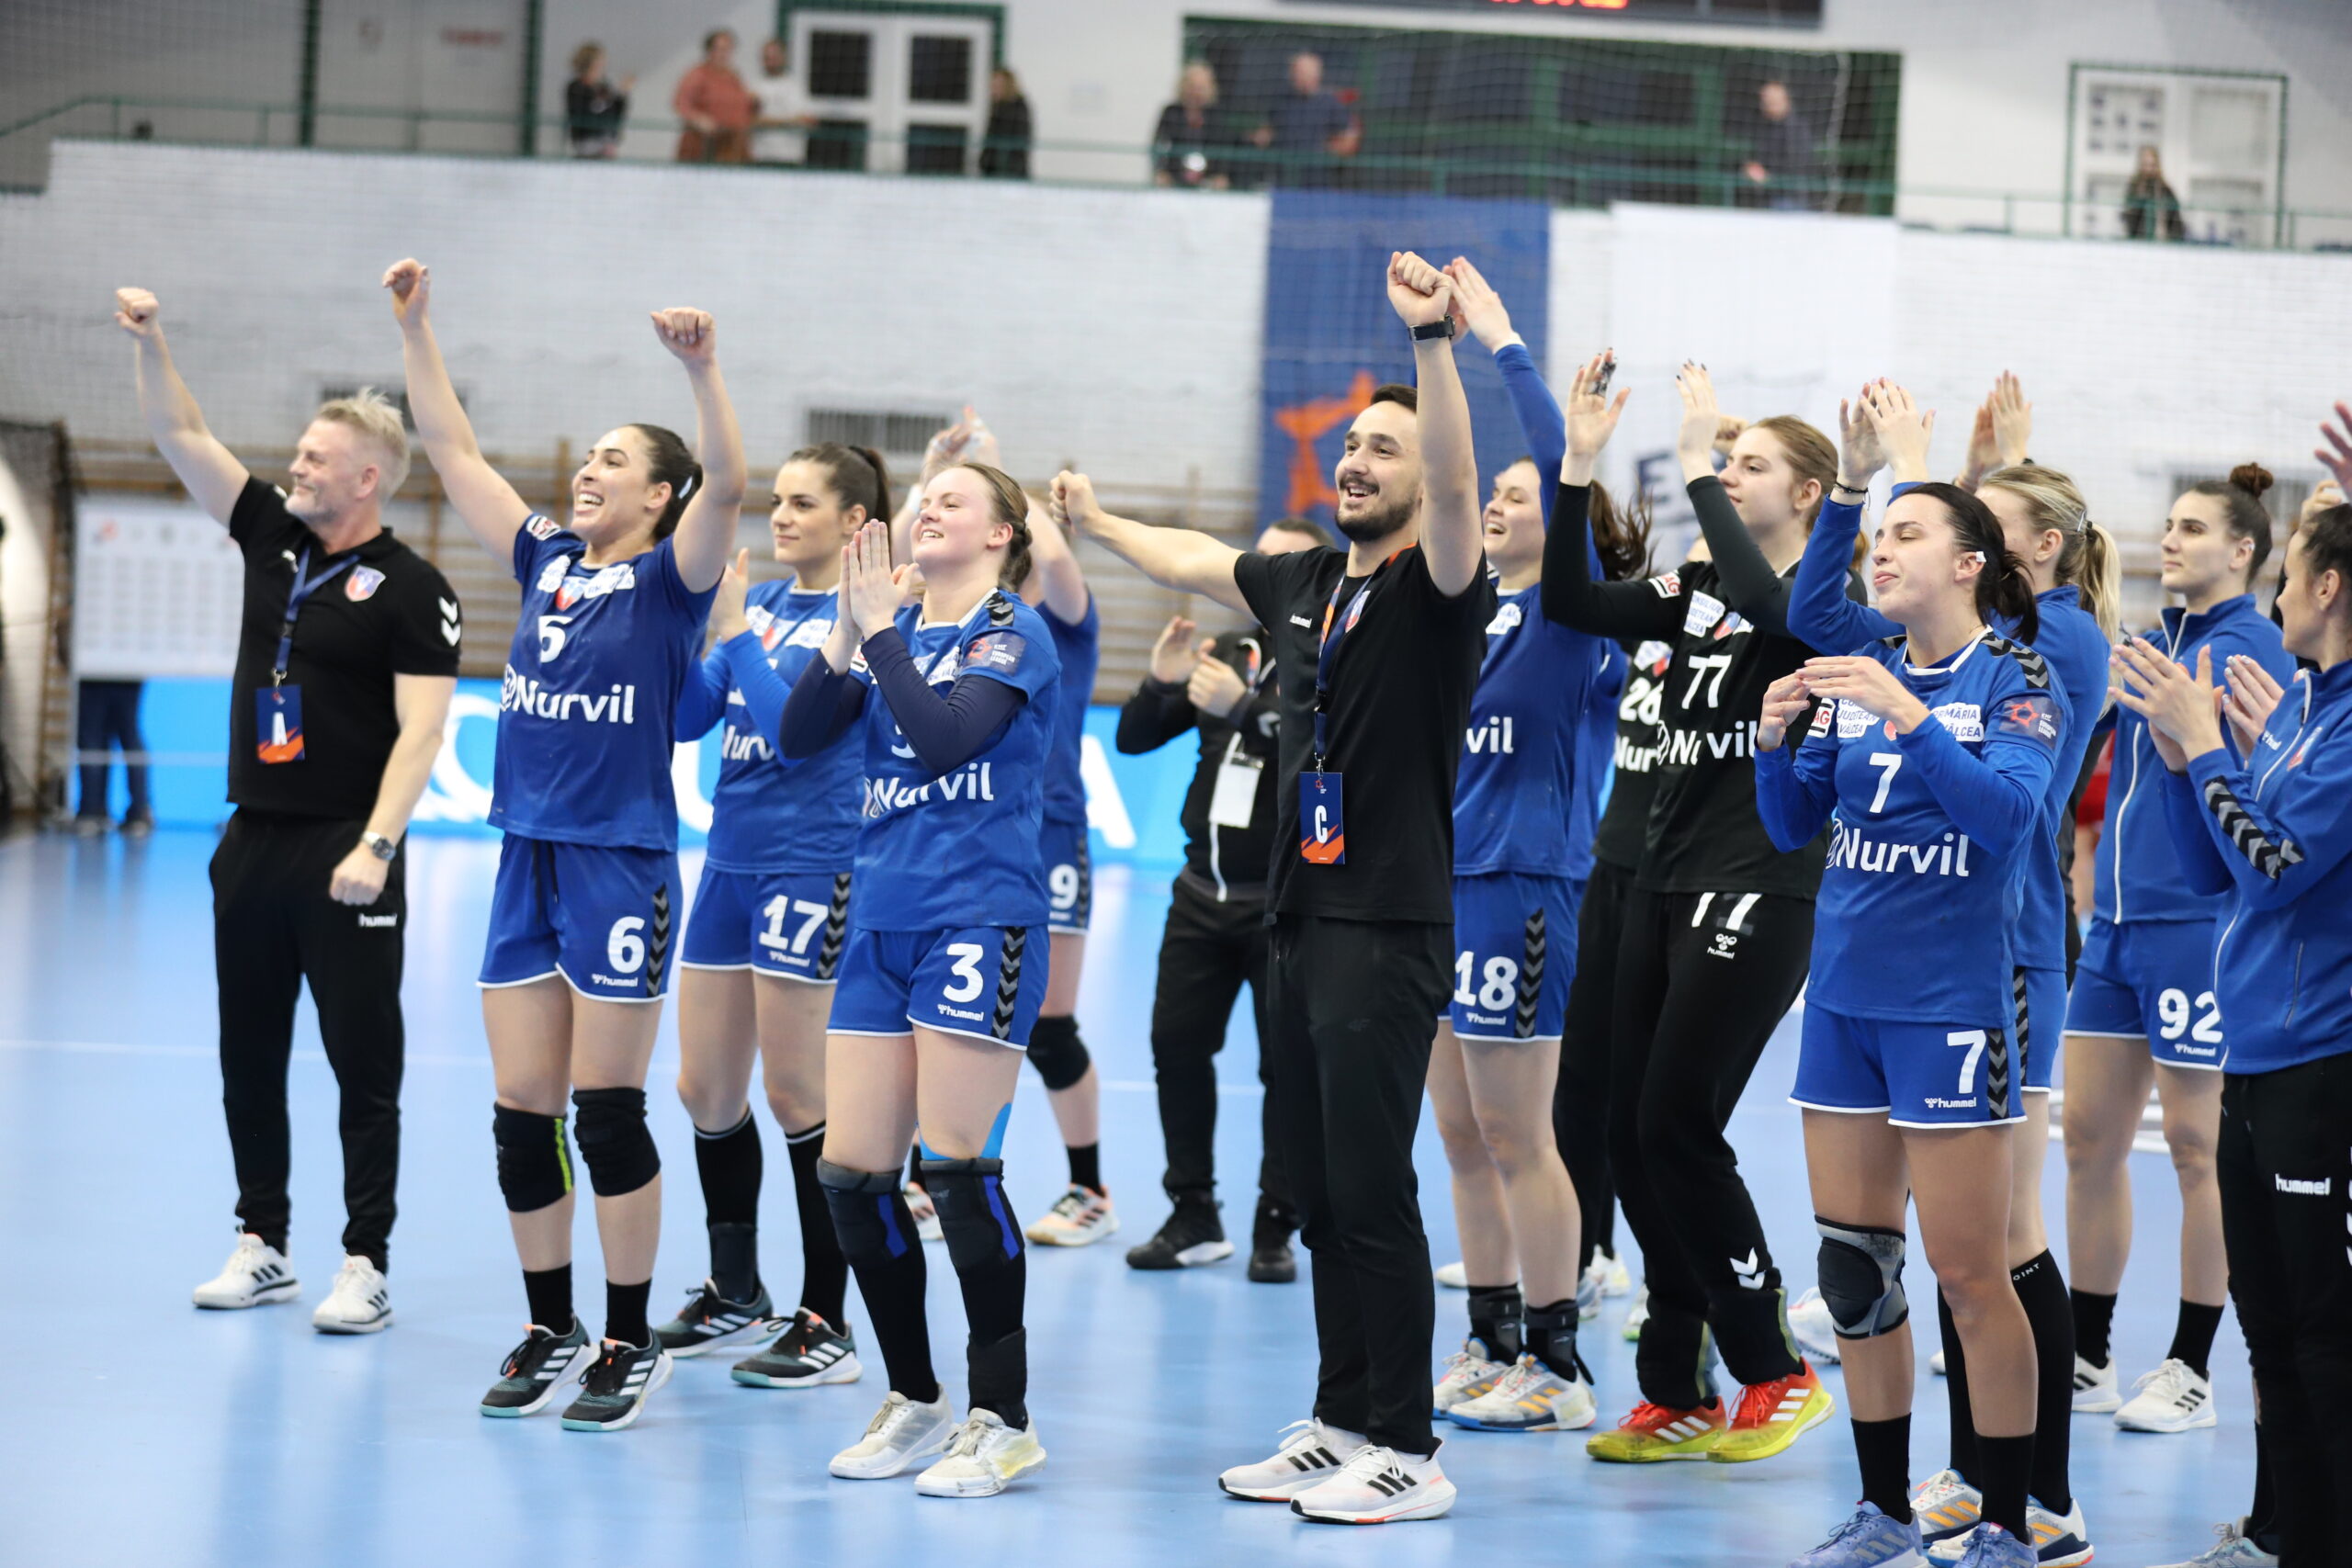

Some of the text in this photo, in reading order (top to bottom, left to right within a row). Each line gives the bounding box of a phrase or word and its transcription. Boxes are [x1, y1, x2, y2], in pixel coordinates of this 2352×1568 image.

[513, 674, 635, 725] Nurvil
[1619, 677, 1665, 726] 26
[1681, 654, 1733, 710] 77
[272, 711, 288, 746] A
[1465, 716, 1514, 754] vil
[1614, 734, 1659, 773] Nur
[870, 761, 994, 814] Nurvil
[1869, 752, 1903, 814] 7
[1315, 805, 1329, 844] C
[1836, 827, 1970, 877] Nurvil
[1048, 863, 1080, 909] 9
[607, 916, 646, 974] 6
[759, 894, 829, 954] 17
[943, 942, 984, 1003] 3
[1707, 946, 1735, 960] hummel
[602, 975, 639, 987] hummel
[1453, 951, 1518, 1010] 18
[945, 1005, 984, 1021] hummel
[2158, 987, 2223, 1043] 92
[1947, 1029, 1987, 1094] 7
[2183, 1044, 2217, 1056] hummel
[1938, 1096, 1977, 1108] hummel
[2274, 1172, 2332, 1196] hummel
[2013, 1263, 2040, 1280] OINT
